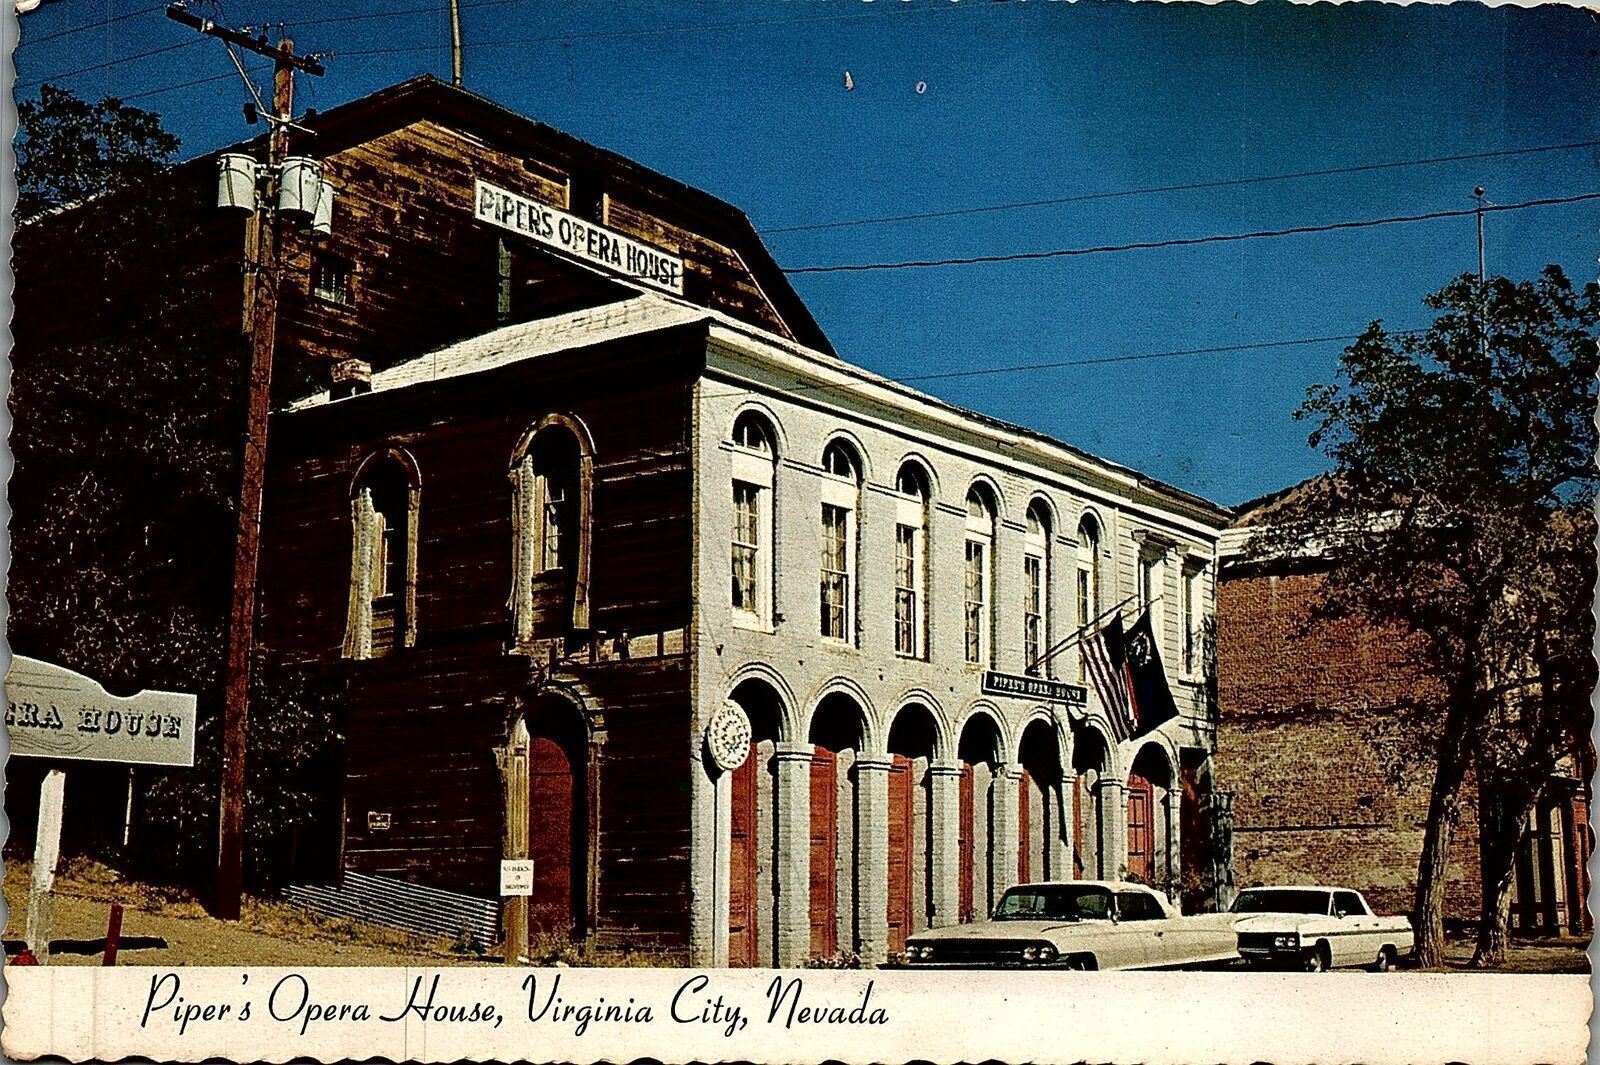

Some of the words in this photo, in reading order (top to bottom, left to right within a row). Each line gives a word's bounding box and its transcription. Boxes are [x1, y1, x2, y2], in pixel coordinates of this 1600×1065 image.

[558, 216, 622, 267] OPERA
[626, 242, 679, 288] HOUSE
[78, 707, 182, 739] HOUSE
